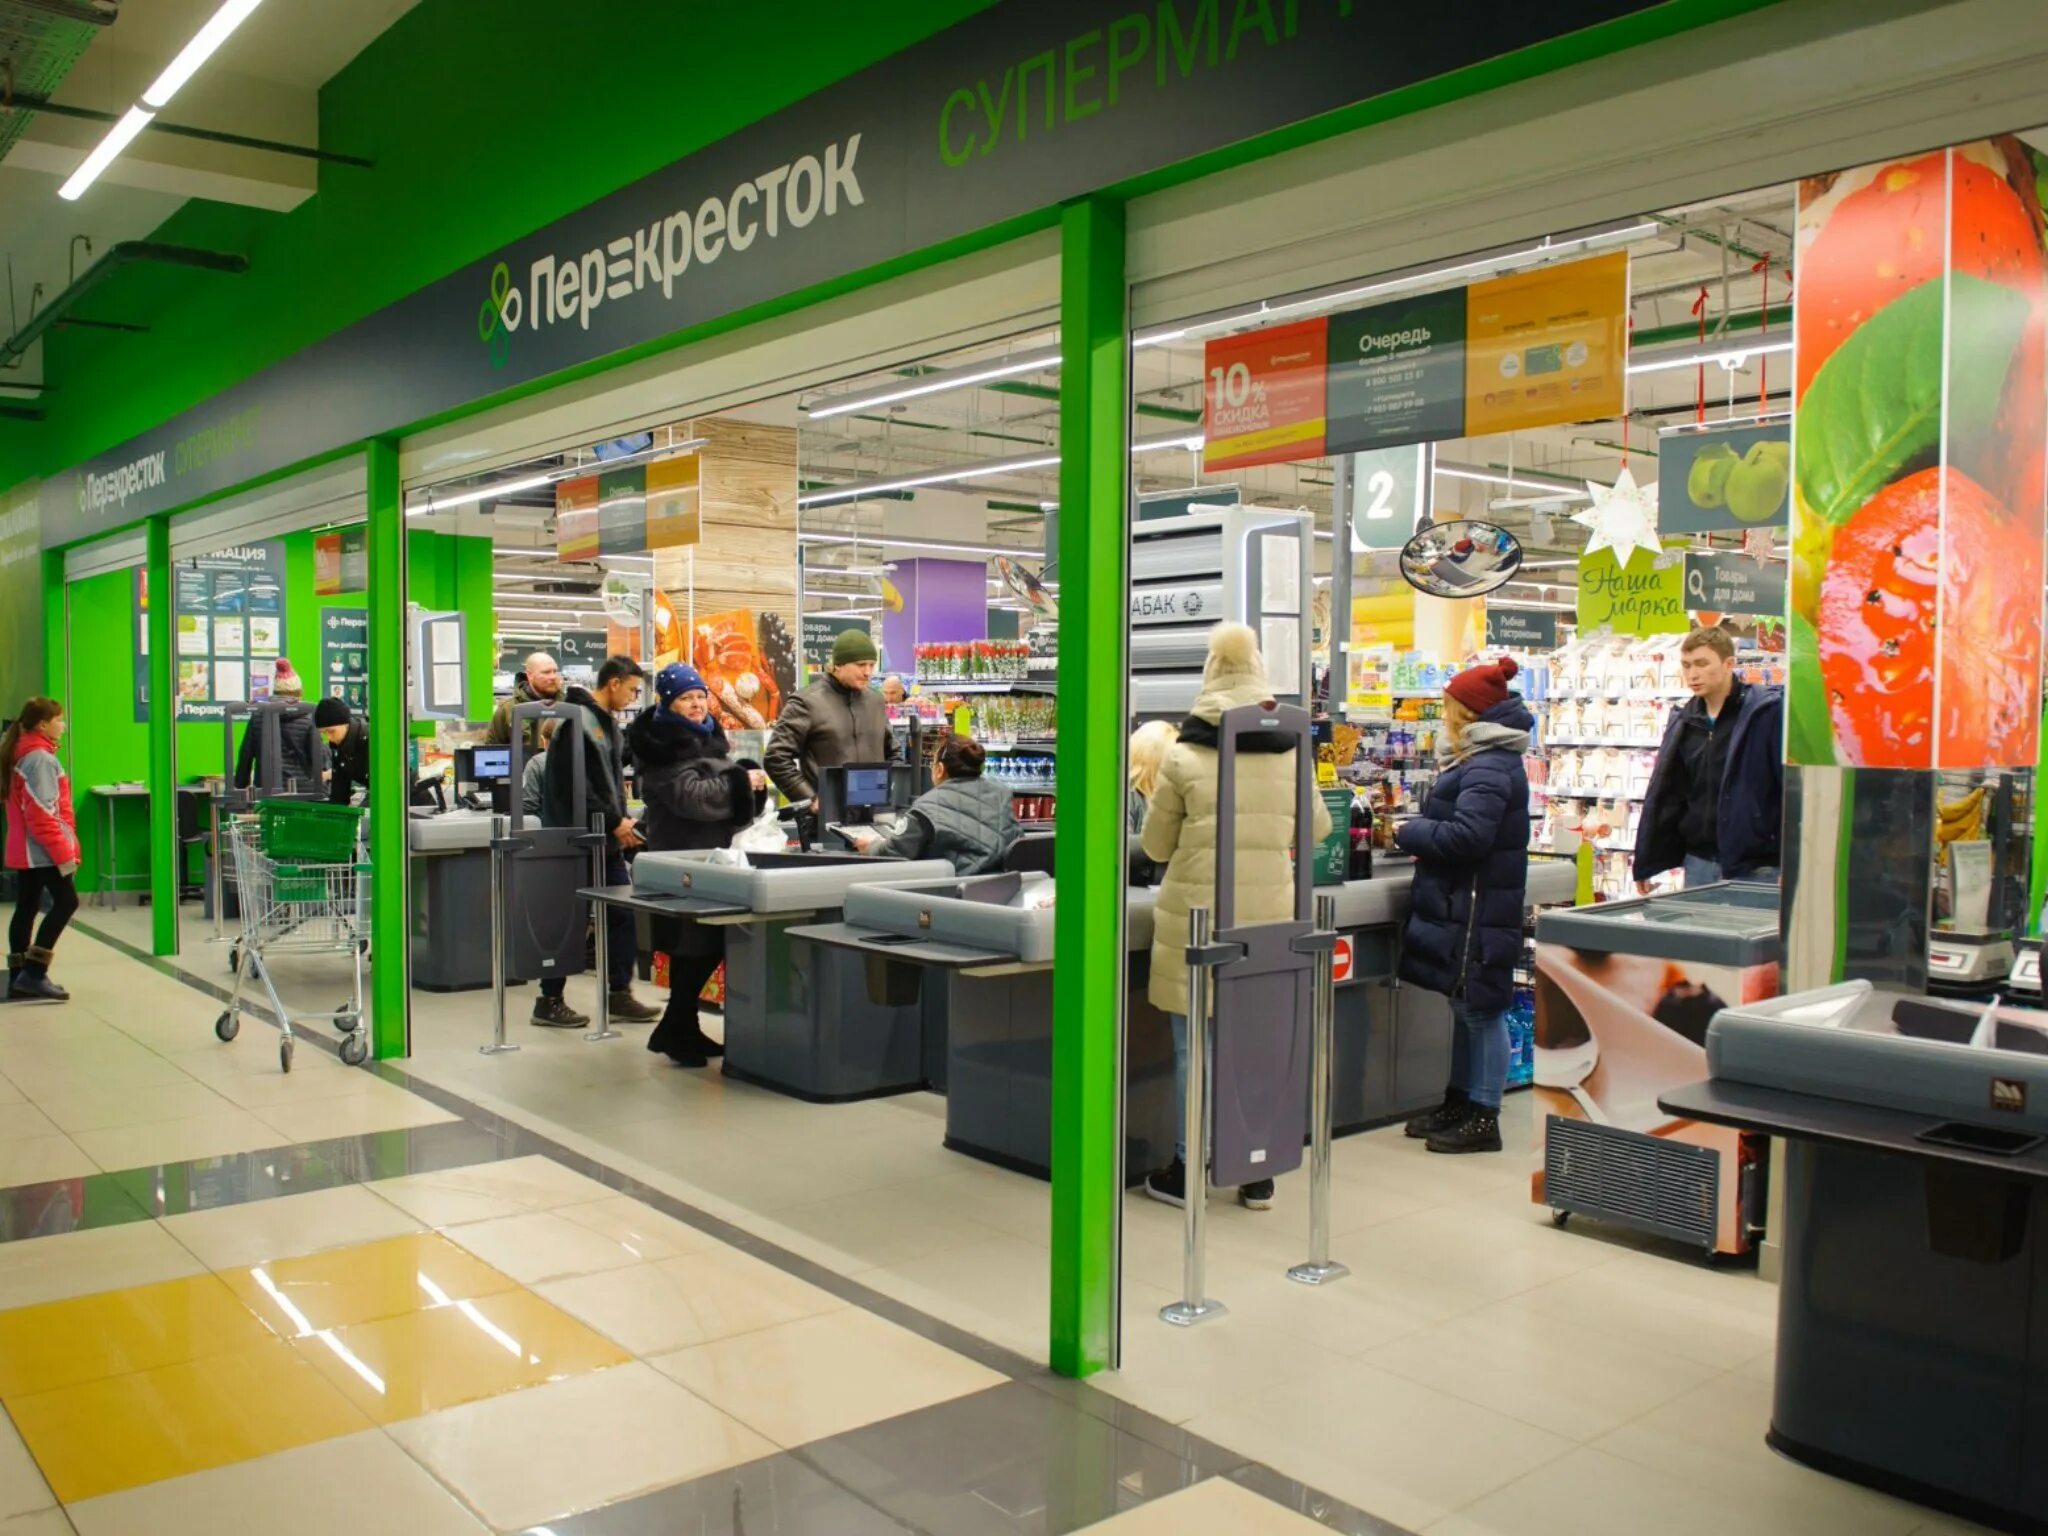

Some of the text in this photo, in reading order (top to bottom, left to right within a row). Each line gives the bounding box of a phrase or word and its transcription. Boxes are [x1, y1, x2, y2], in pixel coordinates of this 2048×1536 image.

[938, 0, 1353, 168] СУПЕРМА
[530, 132, 865, 330] Перекресток
[1359, 327, 1432, 352] Очередь
[1214, 404, 1270, 426] СКИДКА
[87, 449, 166, 515] Перекресток
[1367, 470, 1395, 520] 2
[1582, 563, 1662, 598] Наша
[1714, 565, 1748, 587] Товары
[1713, 587, 1756, 604] для дома
